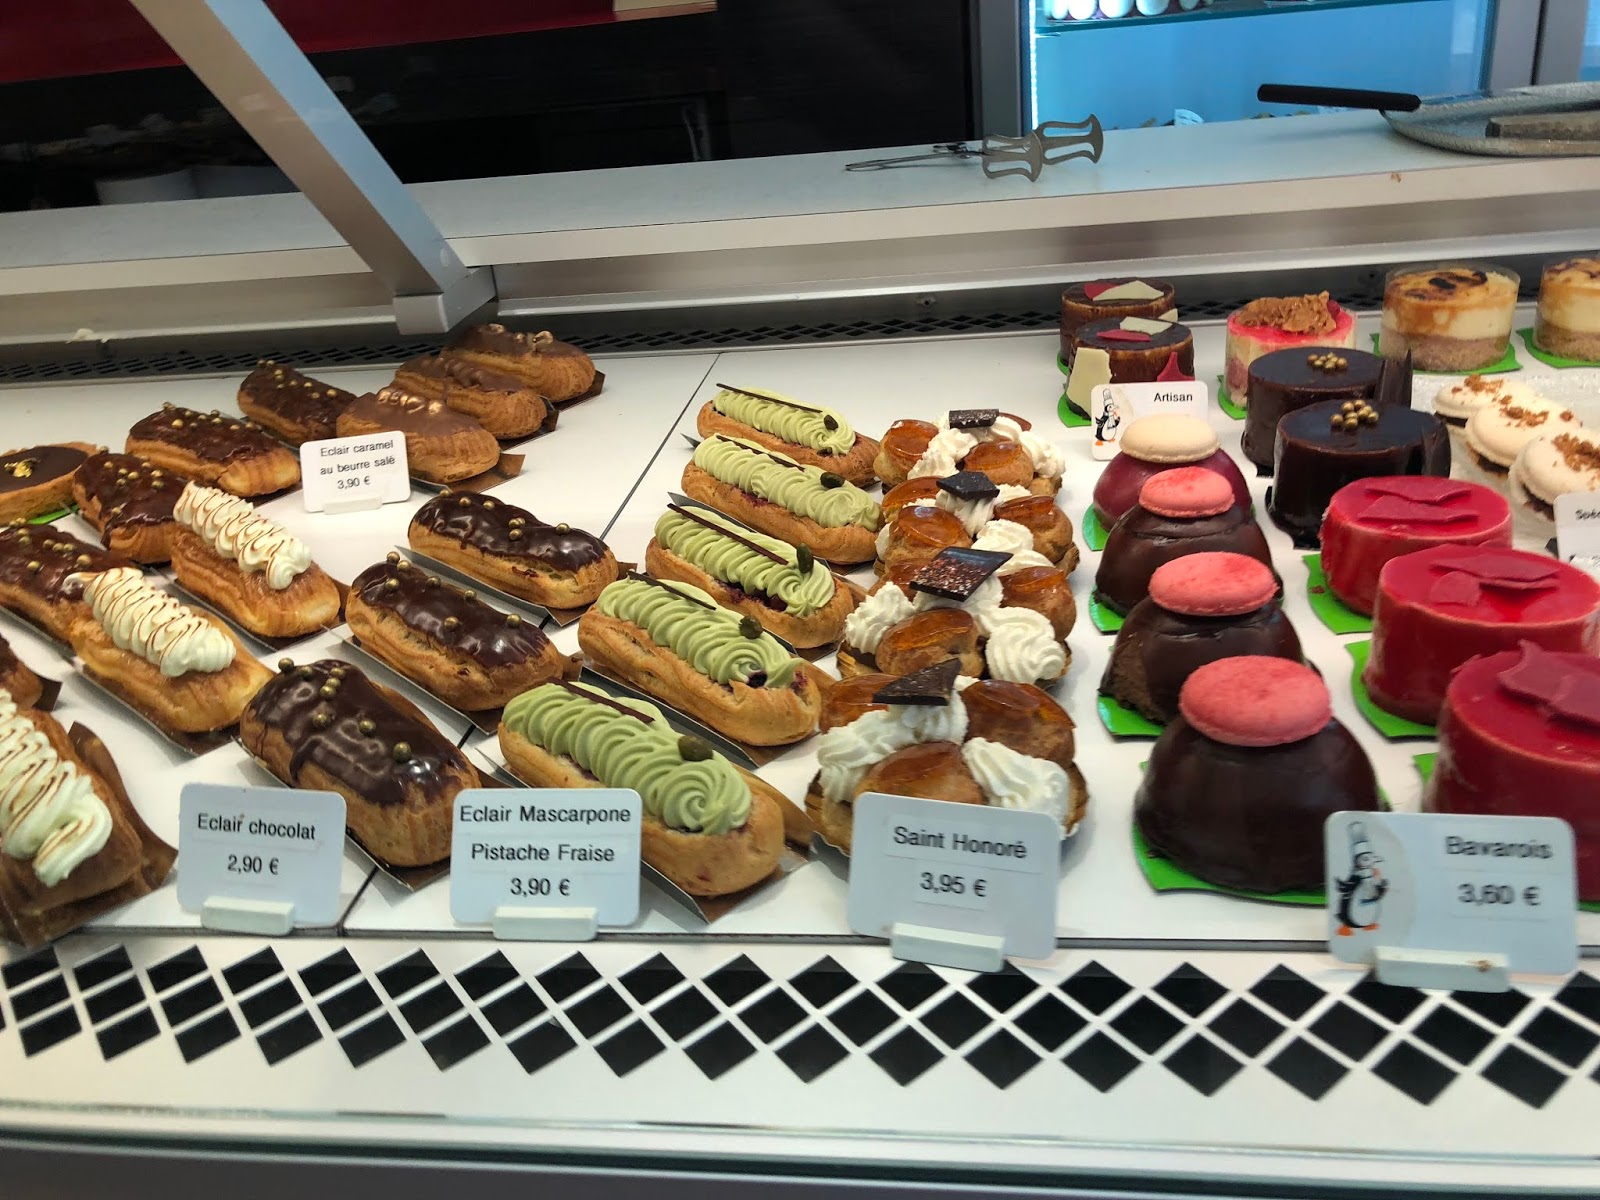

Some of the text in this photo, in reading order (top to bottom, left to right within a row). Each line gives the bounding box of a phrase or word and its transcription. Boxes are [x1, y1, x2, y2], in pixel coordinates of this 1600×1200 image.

[1154, 392, 1193, 402] Artisan
[320, 440, 394, 457] Eclair caramel
[320, 455, 395, 475] au beurre salé
[337, 476, 371, 490] 3,90 €
[460, 805, 631, 825] Eclair Mascarpone
[198, 813, 316, 840] Eclair chocolat
[471, 843, 614, 861] Pistache Fraise
[893, 826, 1027, 858] Saint Honoré
[1446, 836, 1553, 859] Bavarois
[227, 854, 279, 875] 2,90 €
[510, 878, 571, 897] 3,90 €
[920, 871, 987, 897] 3,95 €
[1523, 886, 1541, 906] €
